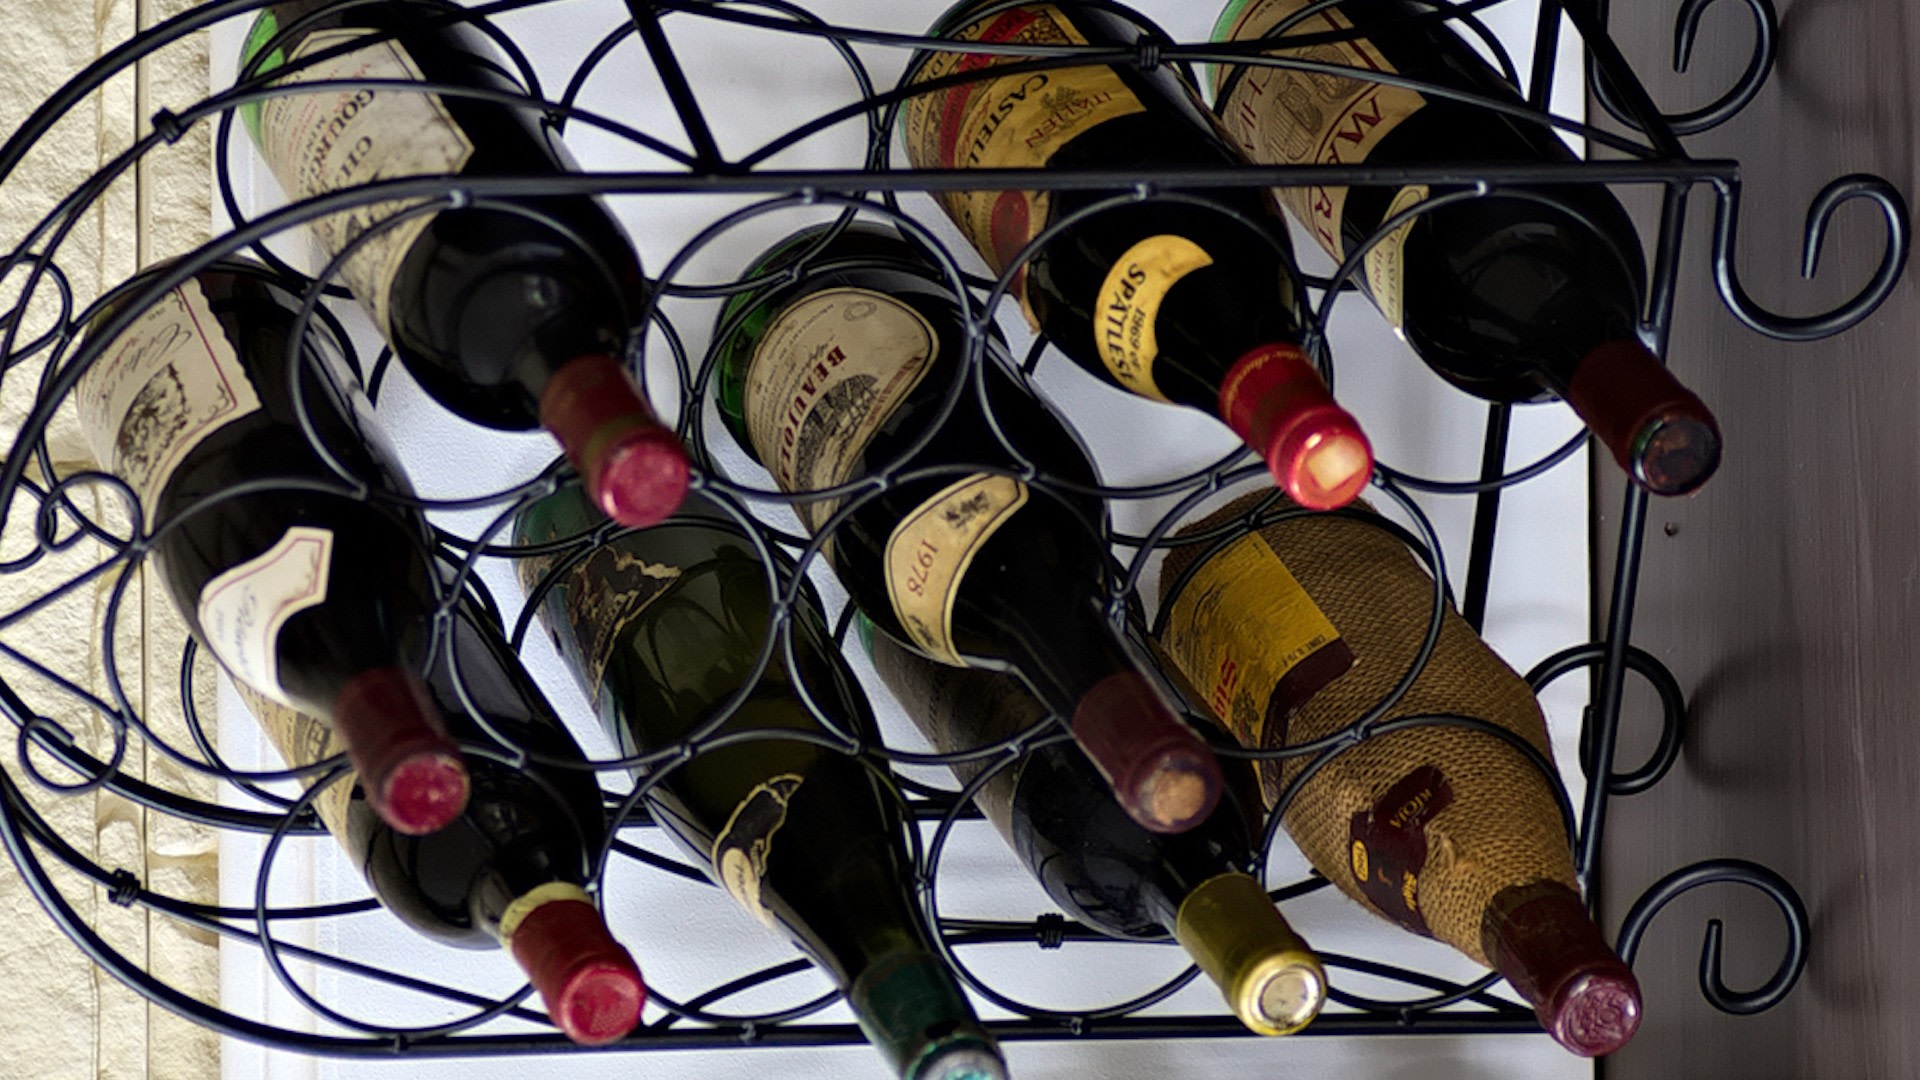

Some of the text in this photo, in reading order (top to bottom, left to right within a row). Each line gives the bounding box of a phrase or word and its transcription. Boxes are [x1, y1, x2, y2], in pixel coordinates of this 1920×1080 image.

[968, 73, 1050, 166] CASTELL
[1024, 91, 1112, 150] ITALIEN
[781, 345, 847, 483] BEAUJOLA
[906, 539, 939, 597] 1978
